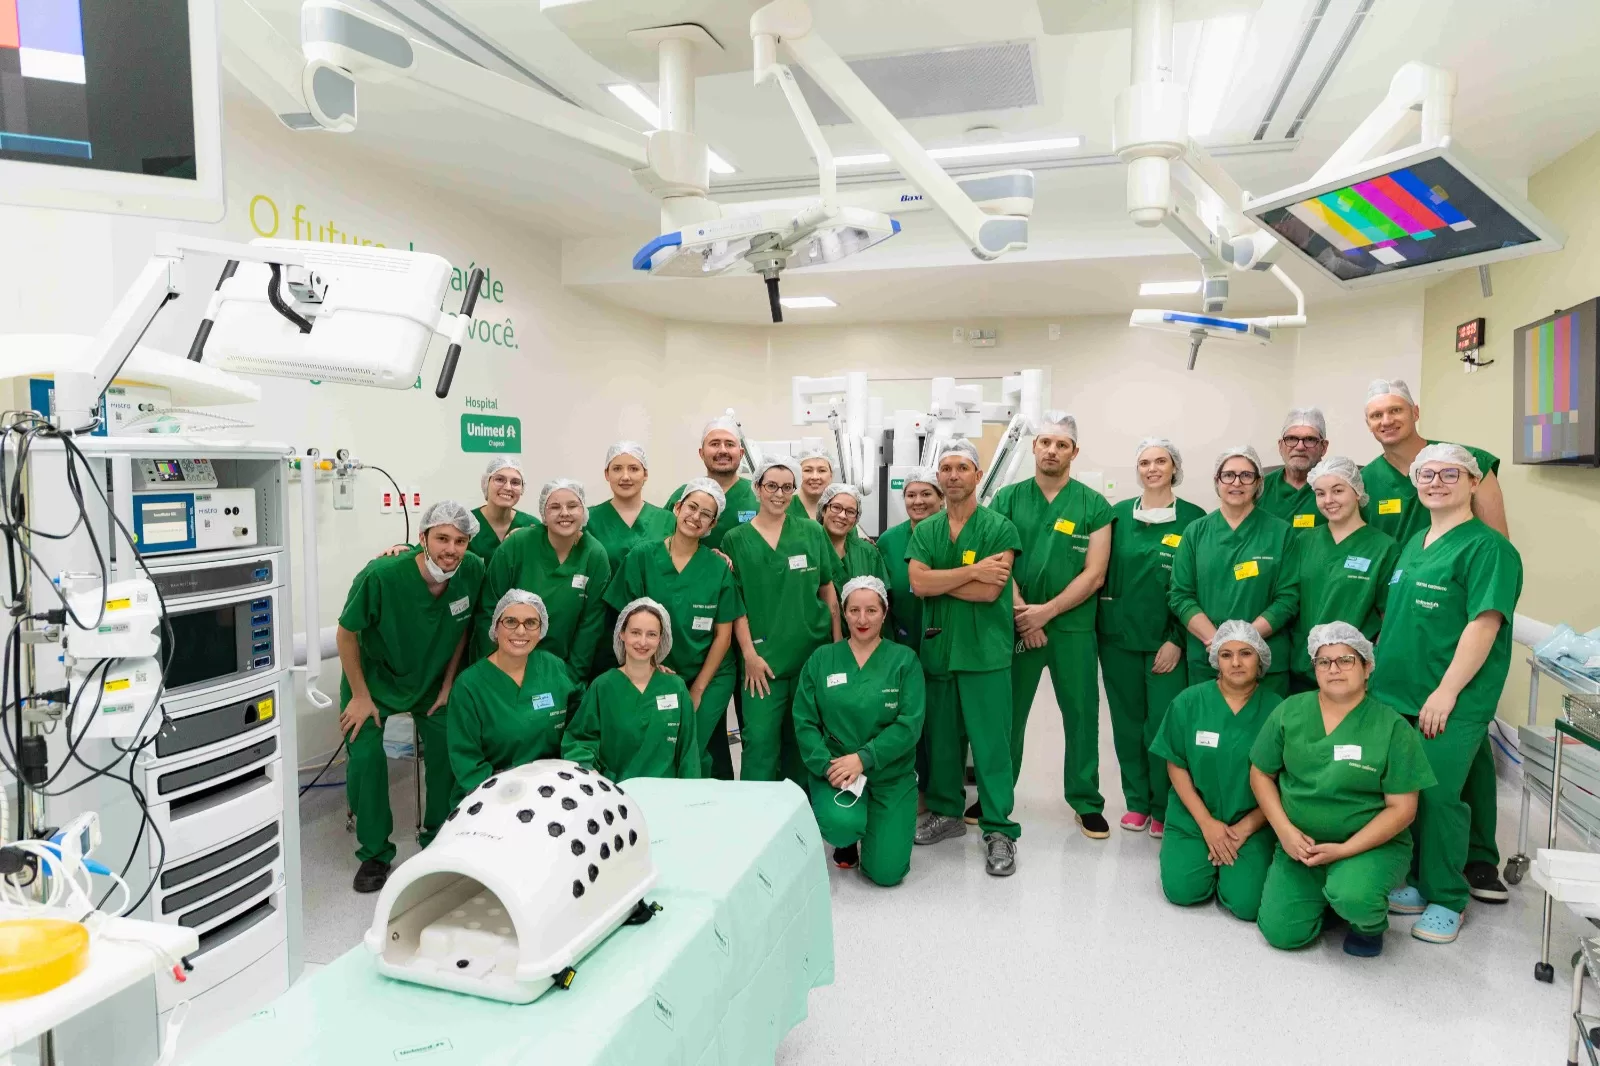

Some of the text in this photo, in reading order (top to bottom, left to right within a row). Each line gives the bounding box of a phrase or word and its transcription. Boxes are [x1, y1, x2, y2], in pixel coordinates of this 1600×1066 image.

[249, 194, 279, 238] O
[465, 395, 498, 412] Hospital
[466, 422, 505, 438] Unimed
